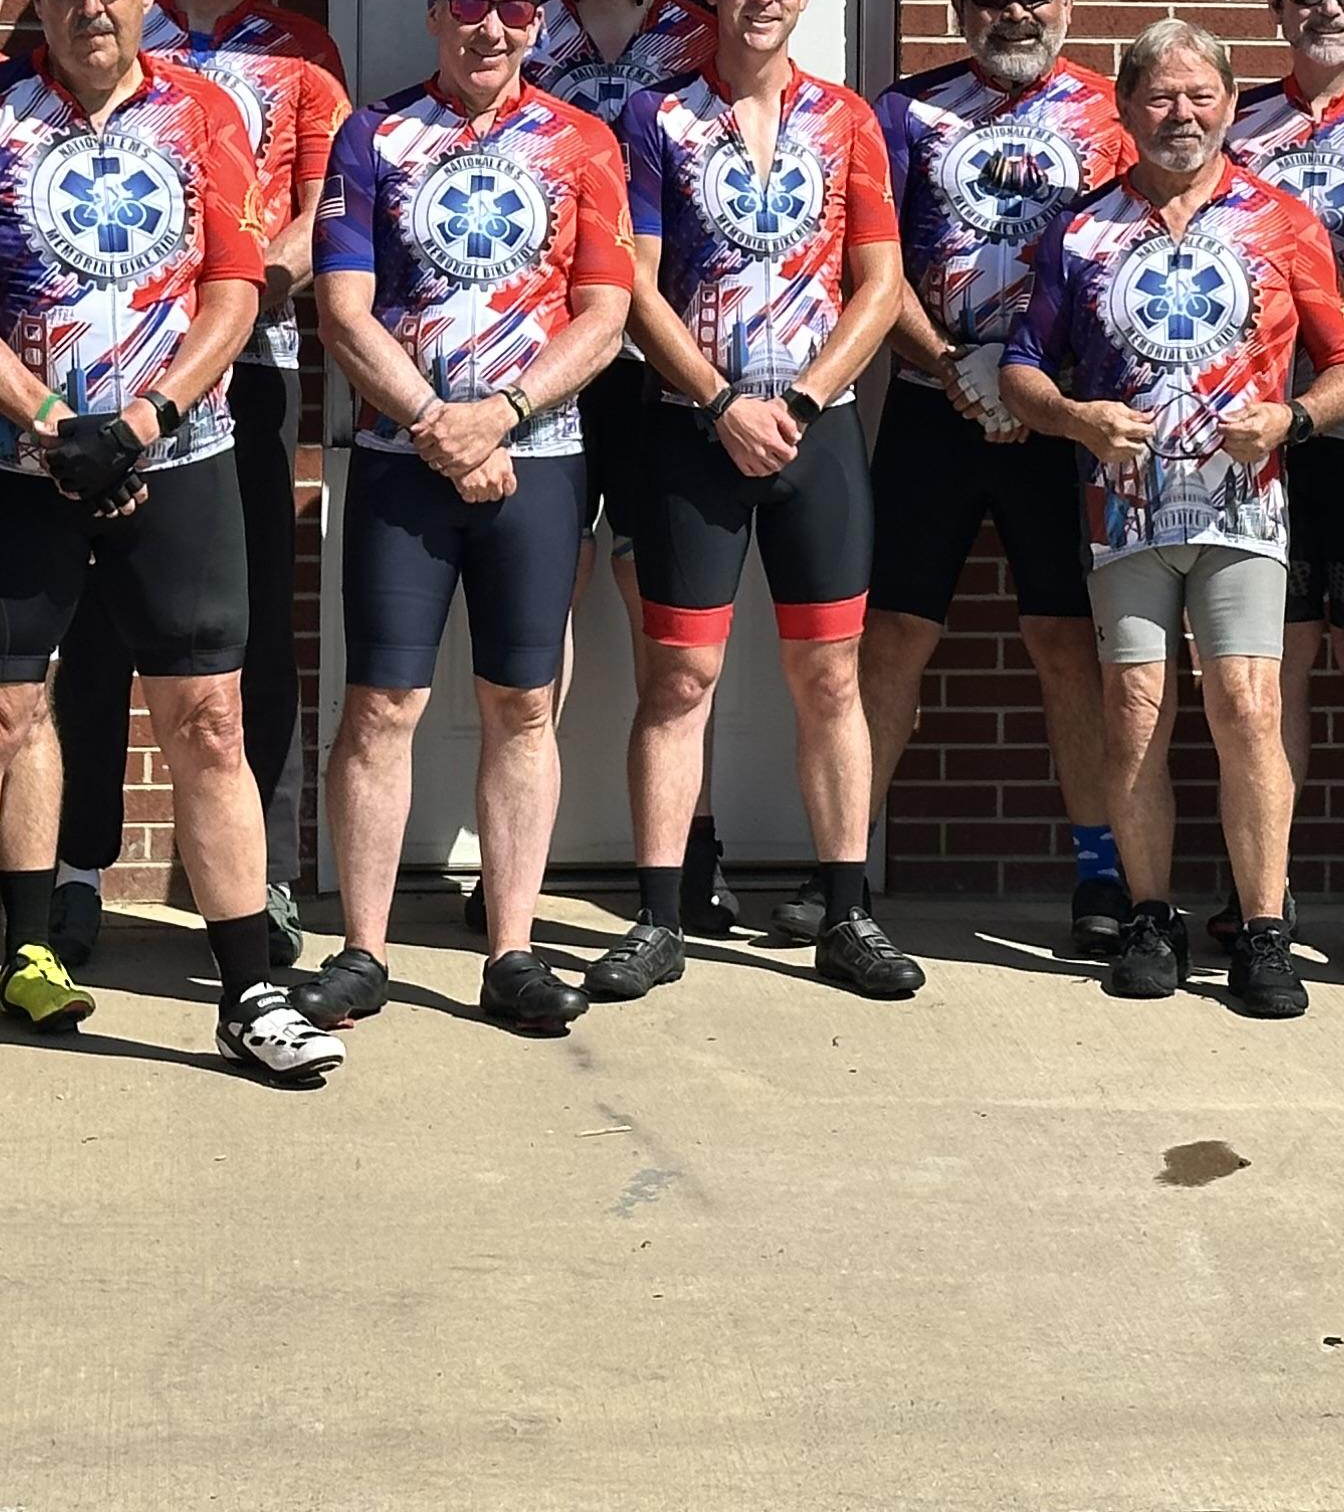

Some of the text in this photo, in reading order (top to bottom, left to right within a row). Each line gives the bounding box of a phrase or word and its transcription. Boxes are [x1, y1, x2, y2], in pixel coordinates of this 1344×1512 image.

[119, 137, 152, 160] EMS
[1276, 152, 1326, 169] NATIONAL
[443, 155, 494, 176] NATIONAL
[45, 228, 180, 276] MEMORIAL BIKE RIDE
[422, 237, 479, 278] MEMORIAL
[1124, 326, 1181, 361] MEMORIAL
[1185, 344, 1215, 361] BIKE
